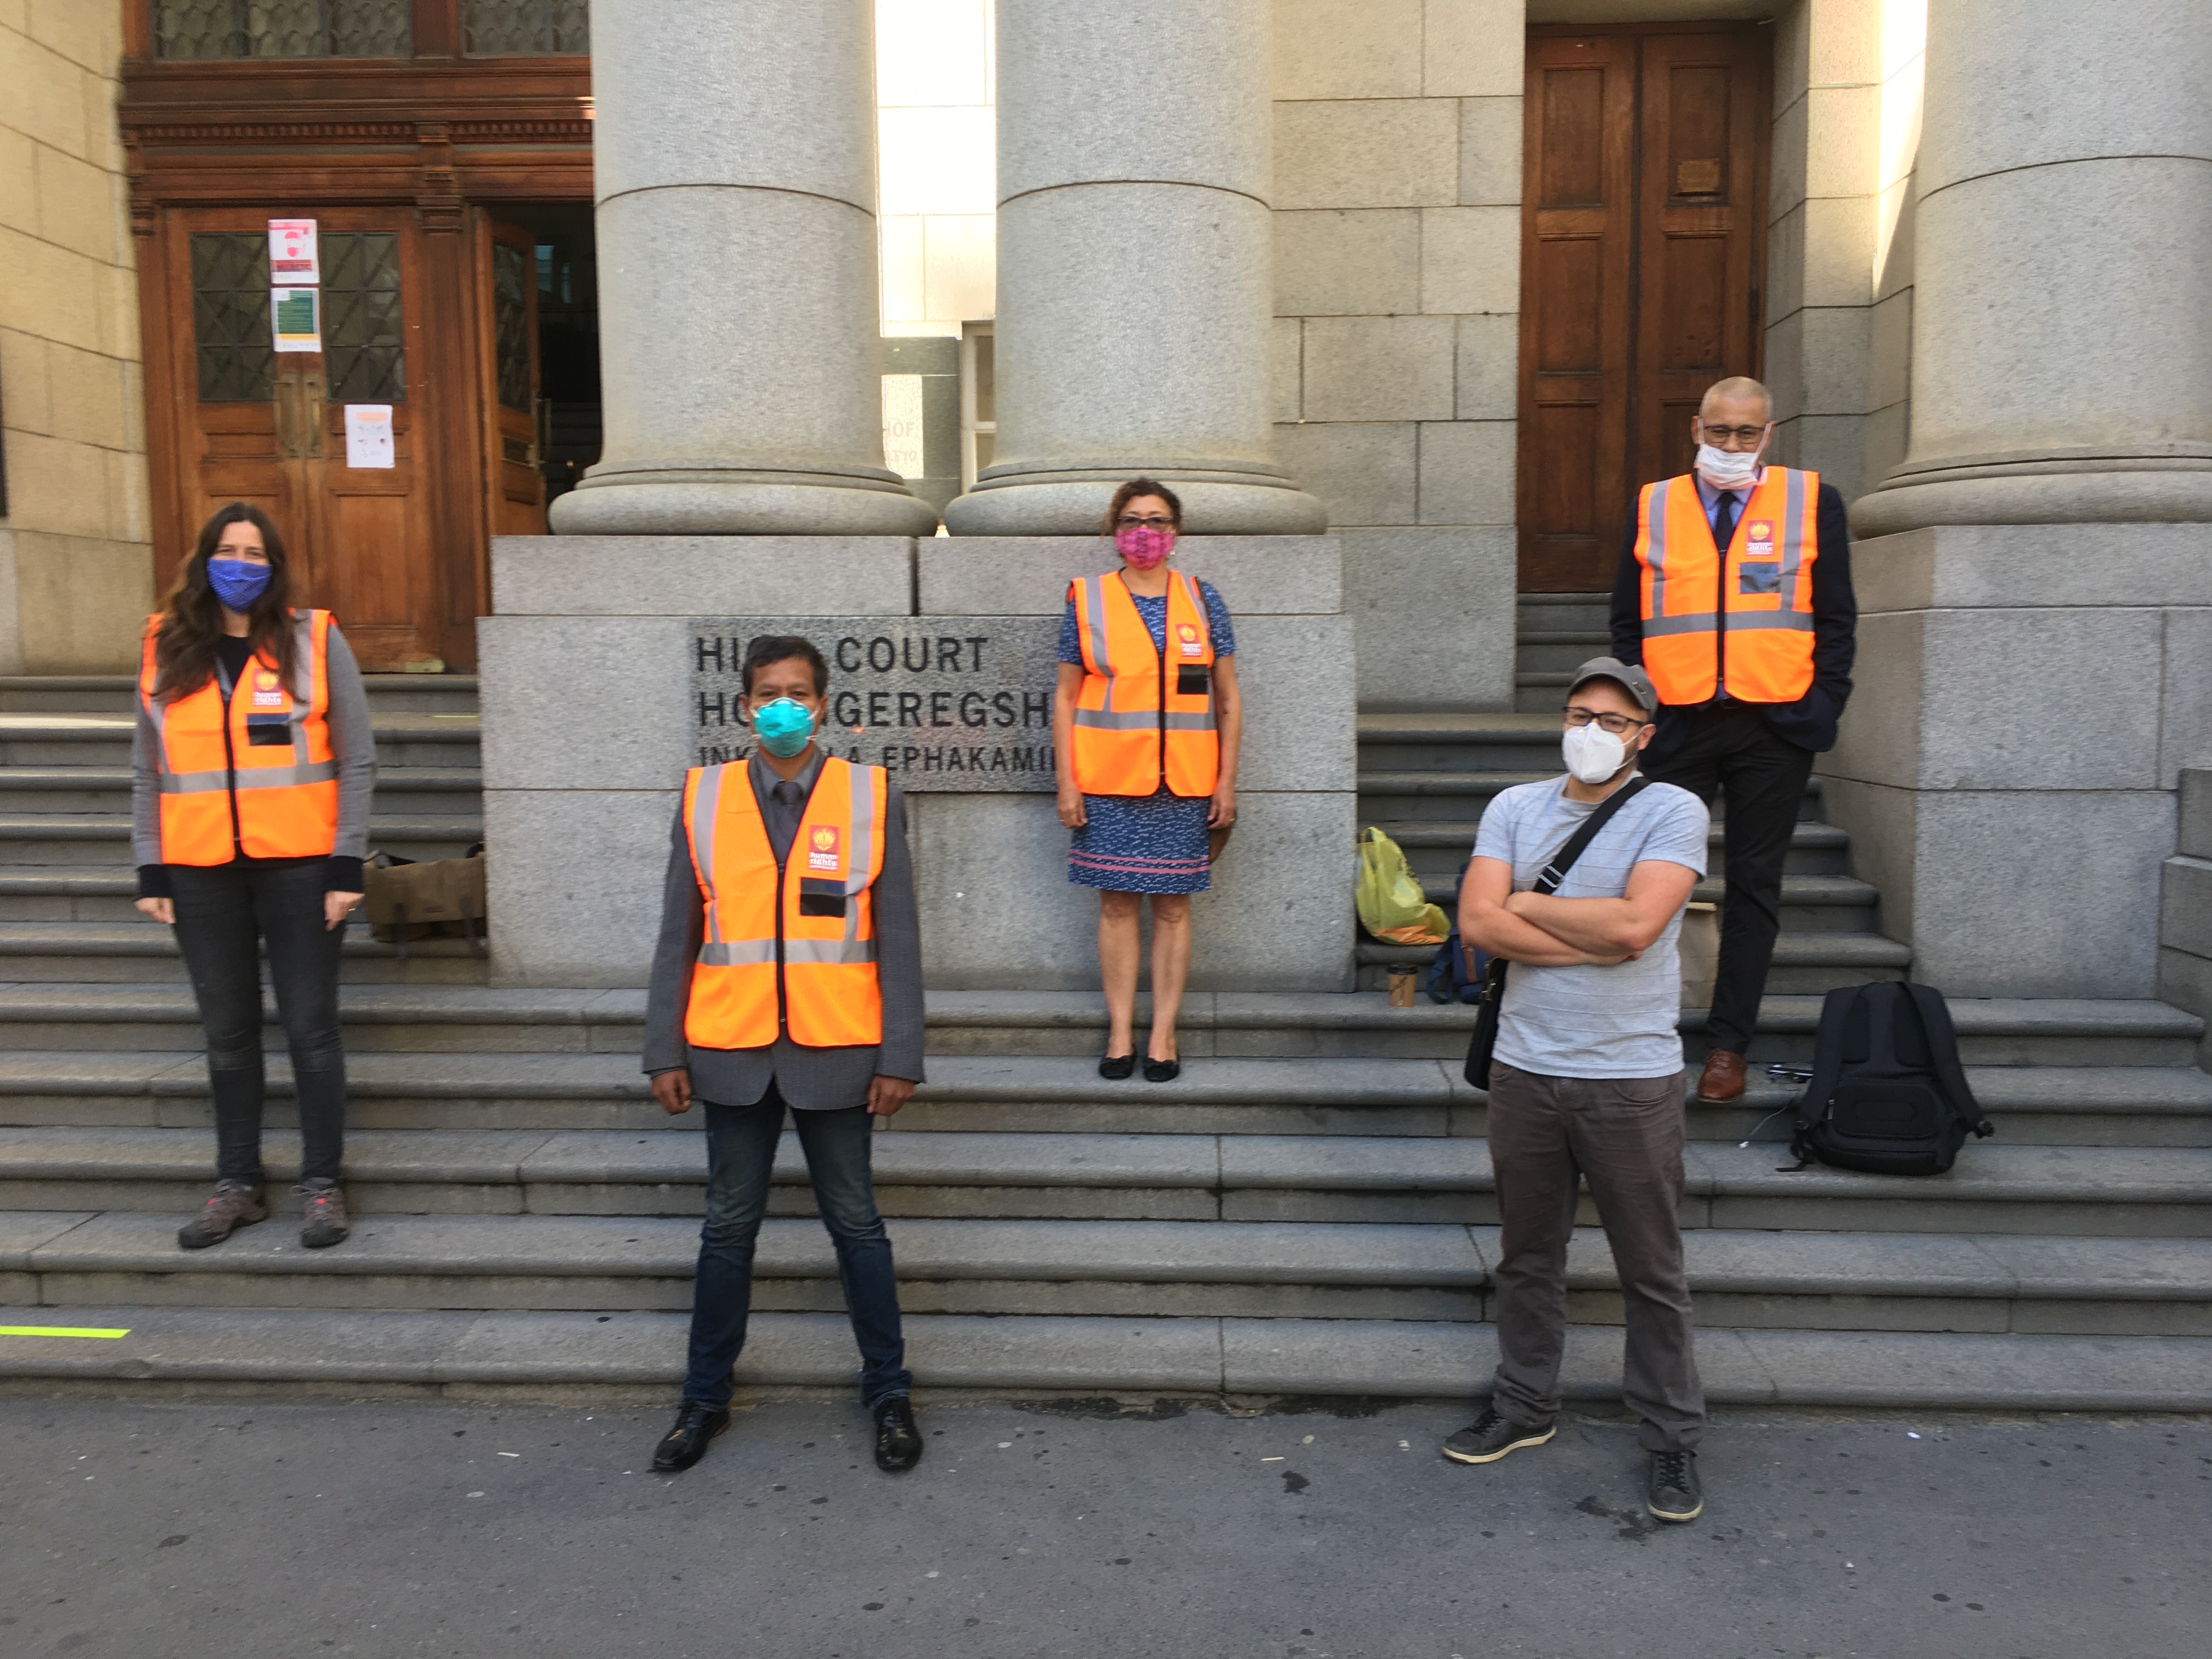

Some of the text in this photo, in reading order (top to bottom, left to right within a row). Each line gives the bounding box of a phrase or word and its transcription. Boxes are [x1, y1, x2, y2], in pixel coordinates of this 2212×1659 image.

[697, 636, 990, 673] HI COURT
[700, 691, 1048, 727] HOGEREGSH
[882, 746, 1056, 771] EPHAKAMI
